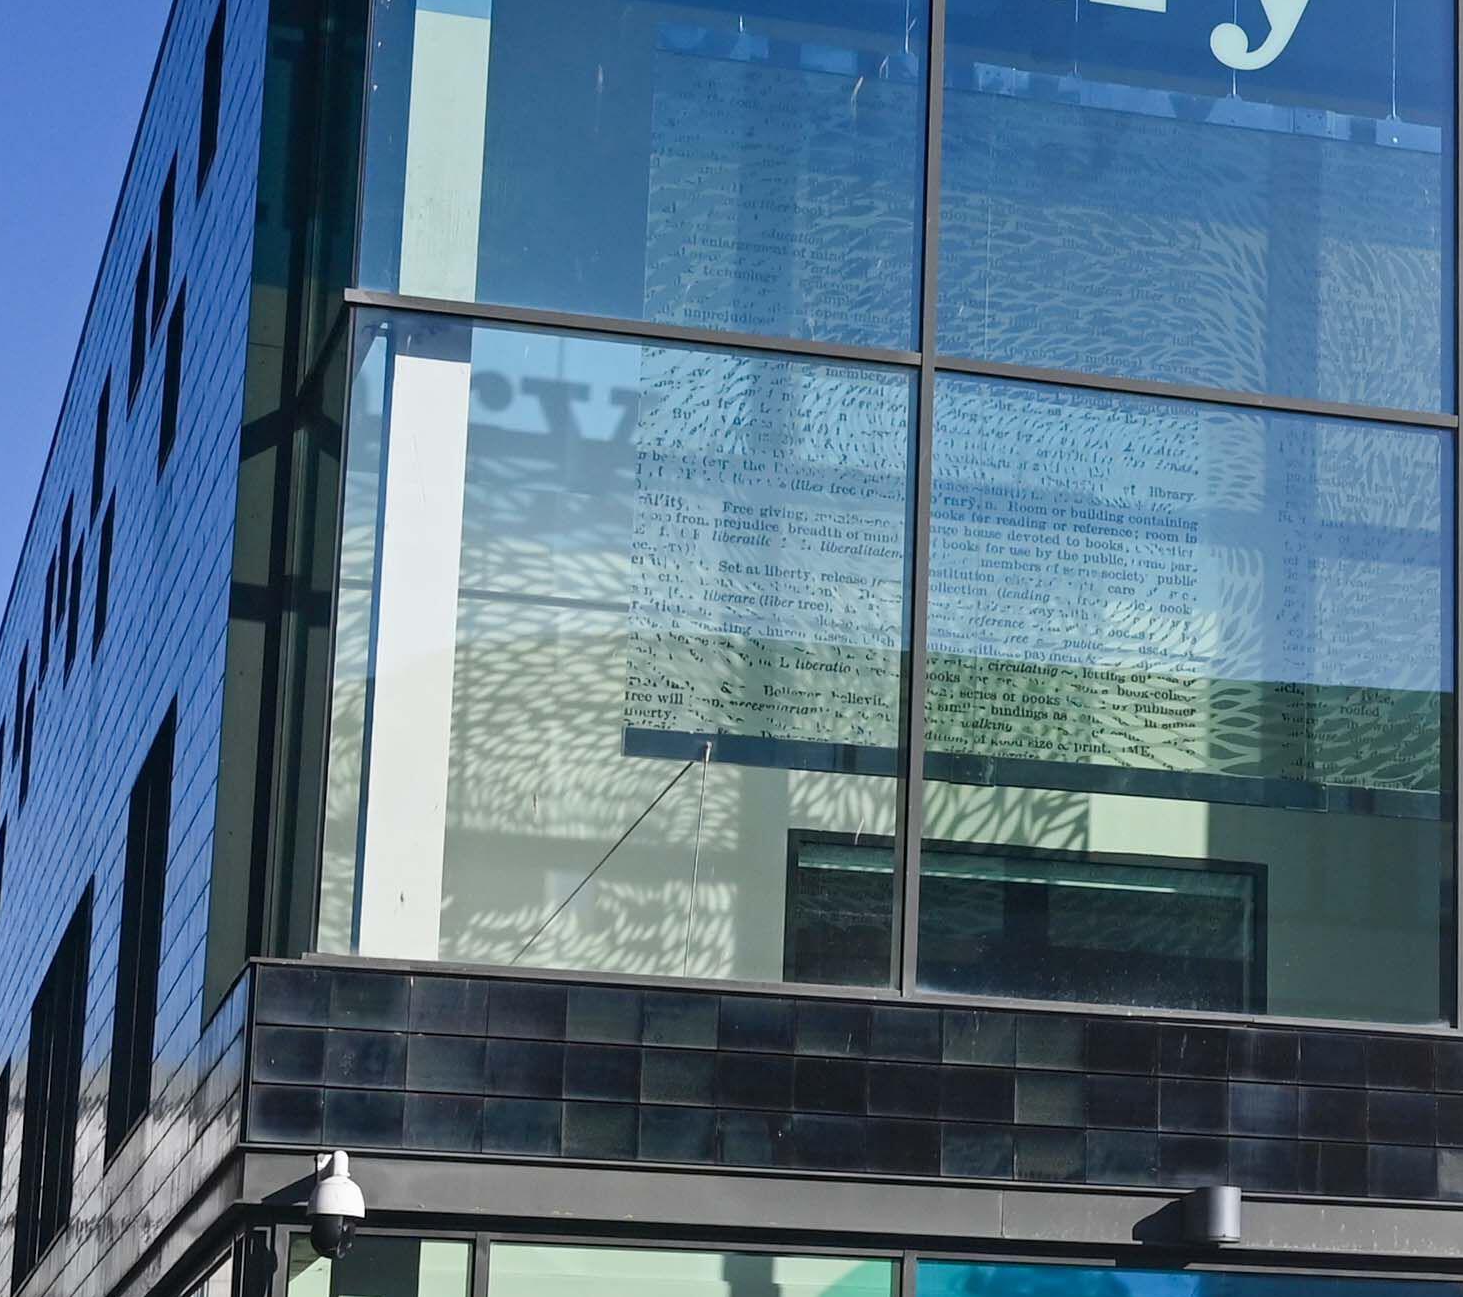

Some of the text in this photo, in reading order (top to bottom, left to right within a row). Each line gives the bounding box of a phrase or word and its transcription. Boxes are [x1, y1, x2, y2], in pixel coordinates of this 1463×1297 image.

[1008, 500, 1047, 515] Room
[1052, 507, 1066, 517] or
[1070, 506, 1124, 524] building
[1129, 515, 1198, 531] containing
[964, 526, 1002, 540] house
[1007, 530, 1060, 545] devoted
[1067, 536, 1079, 547] to
[971, 512, 992, 524] for
[997, 516, 1047, 531] reading
[1053, 522, 1067, 532] or
[1145, 531, 1179, 543] room
[986, 543, 1005, 554] for
[1009, 547, 1031, 557] use
[1036, 547, 1052, 560] by
[1057, 550, 1079, 561] the
[981, 559, 1041, 573] members
[988, 661, 1059, 678] circulating
[991, 705, 1048, 721] bindings
